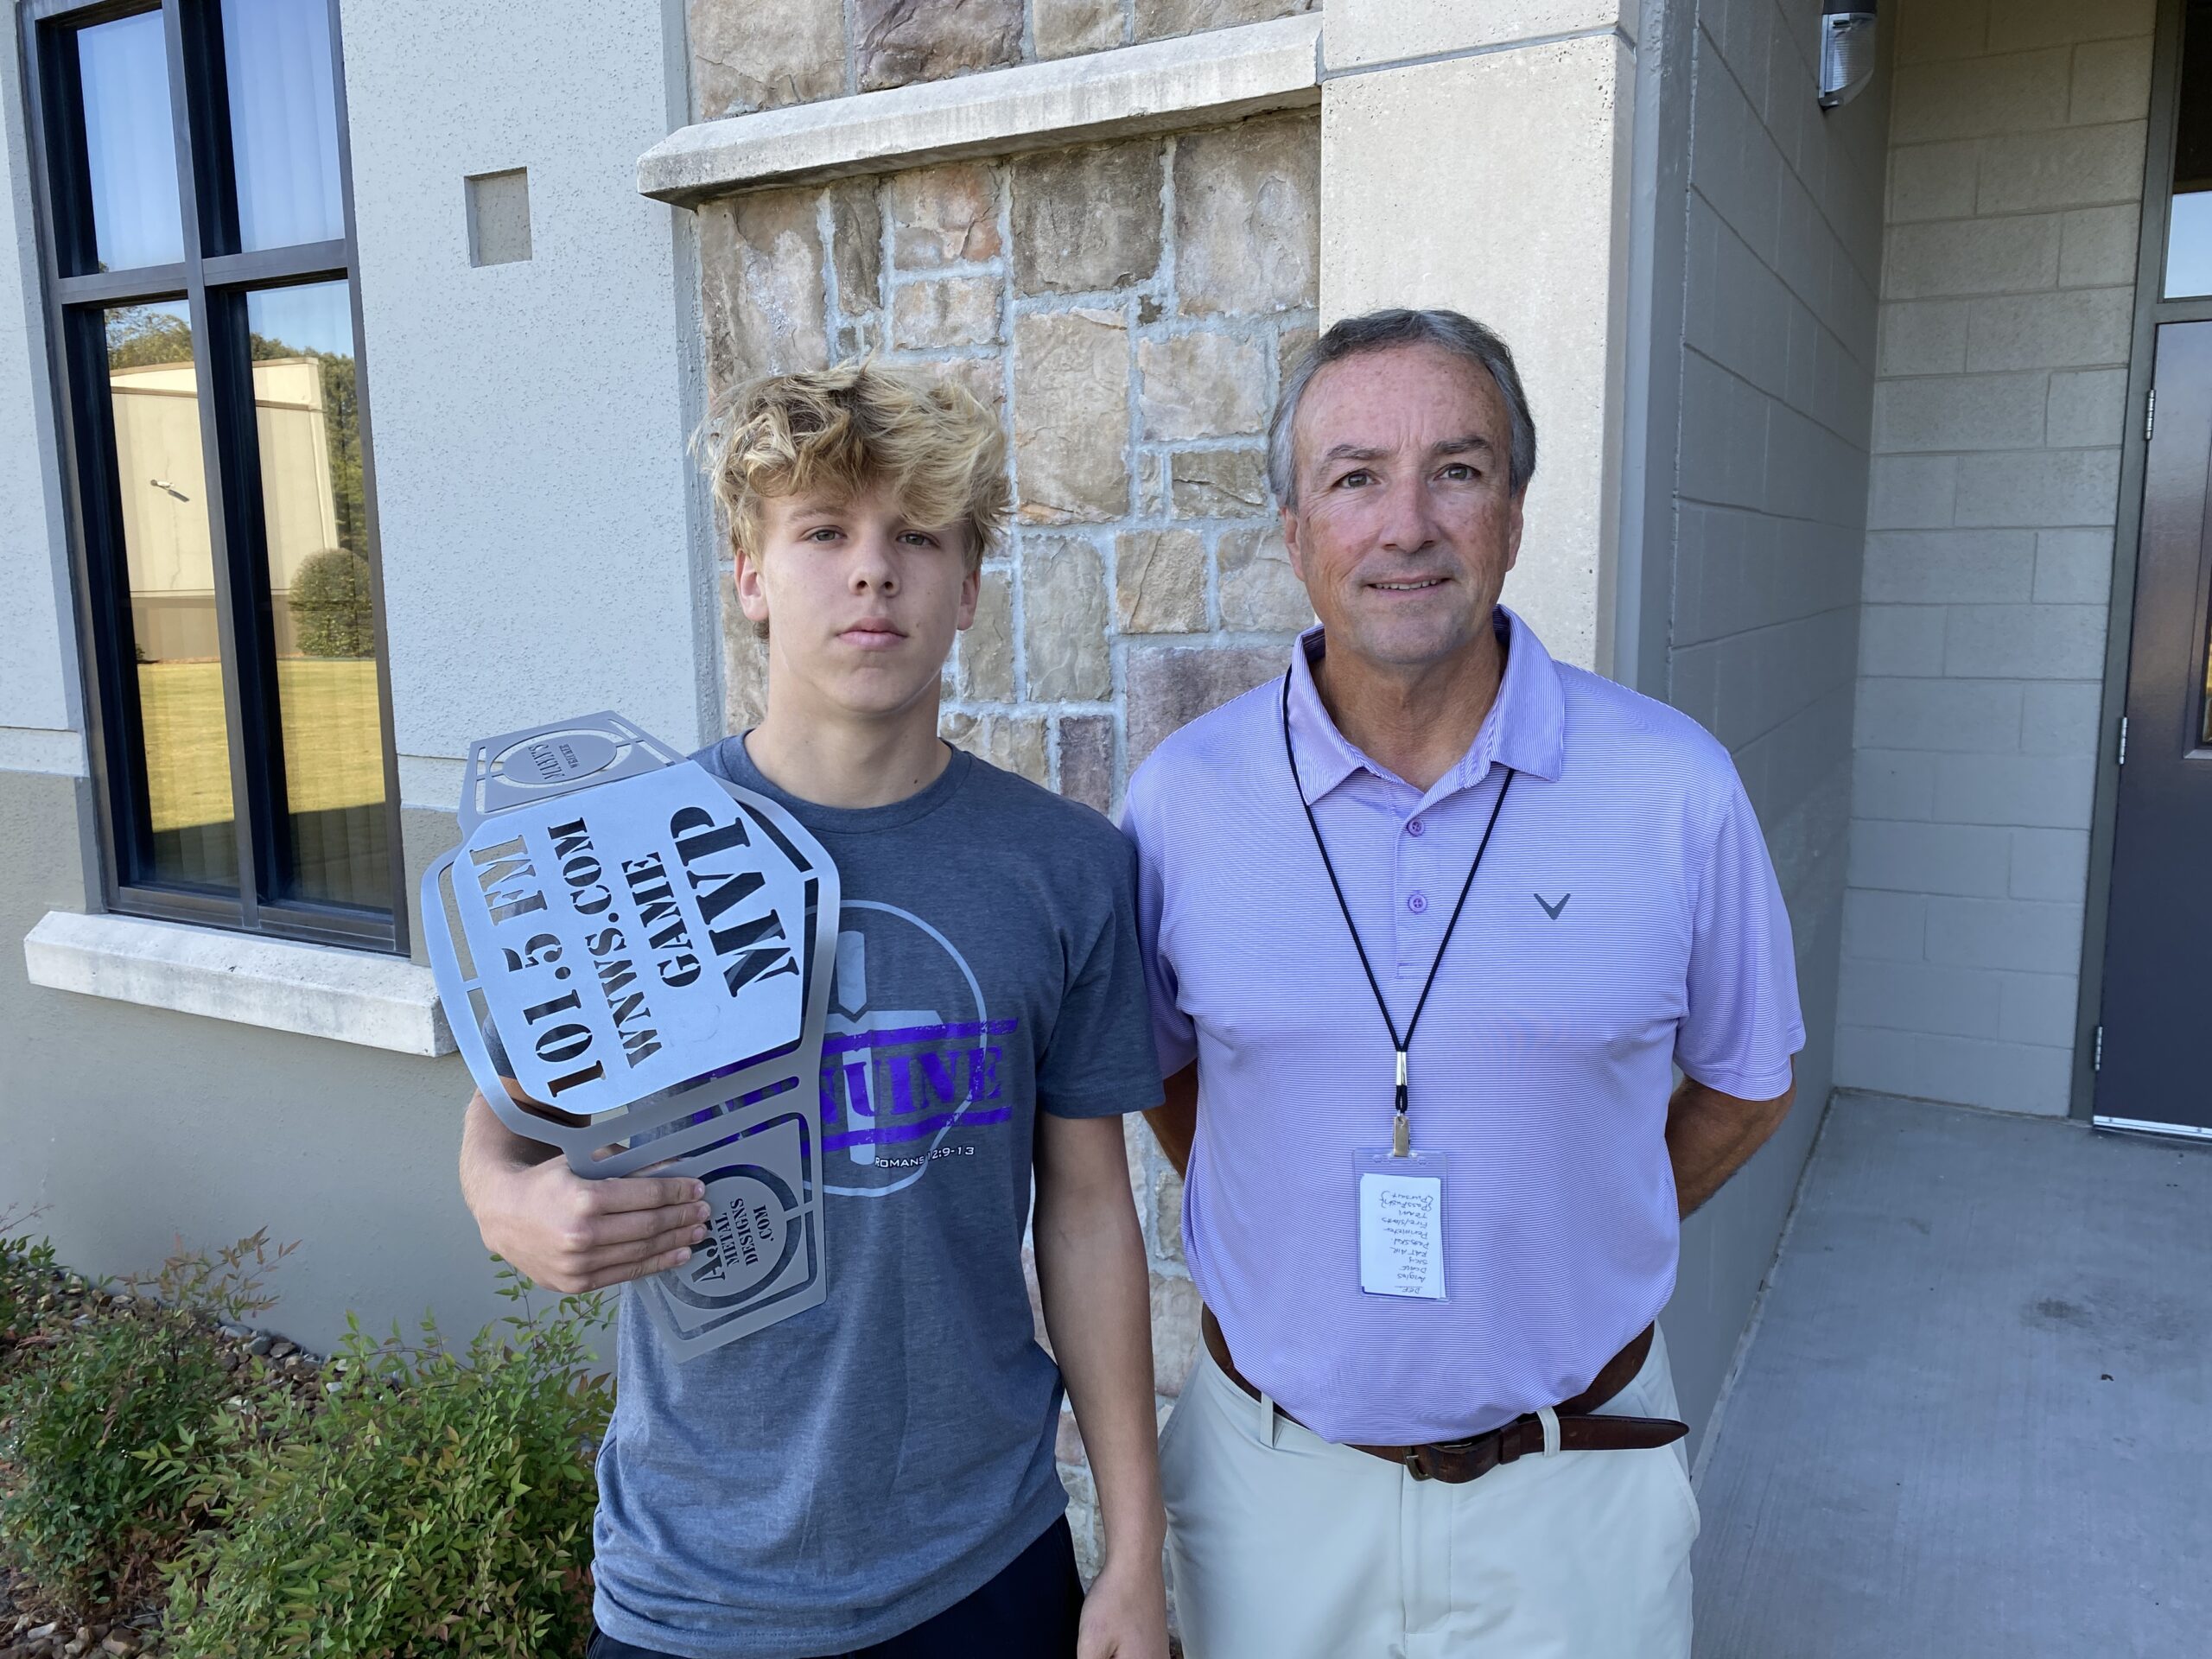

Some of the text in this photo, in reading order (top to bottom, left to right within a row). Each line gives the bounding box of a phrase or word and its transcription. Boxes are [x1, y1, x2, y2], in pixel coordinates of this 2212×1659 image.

[547, 817, 663, 1070] WNWS.COM
[620, 851, 702, 988] GAME
[670, 806, 800, 998] MVP
[468, 834, 607, 1098] 101.5 FM
[874, 1146, 976, 1169] ROMANS 12:9-13
[715, 1211, 741, 1268] METAL
[729, 1198, 760, 1267] DESIGNS
[753, 1204, 775, 1243] .COM
